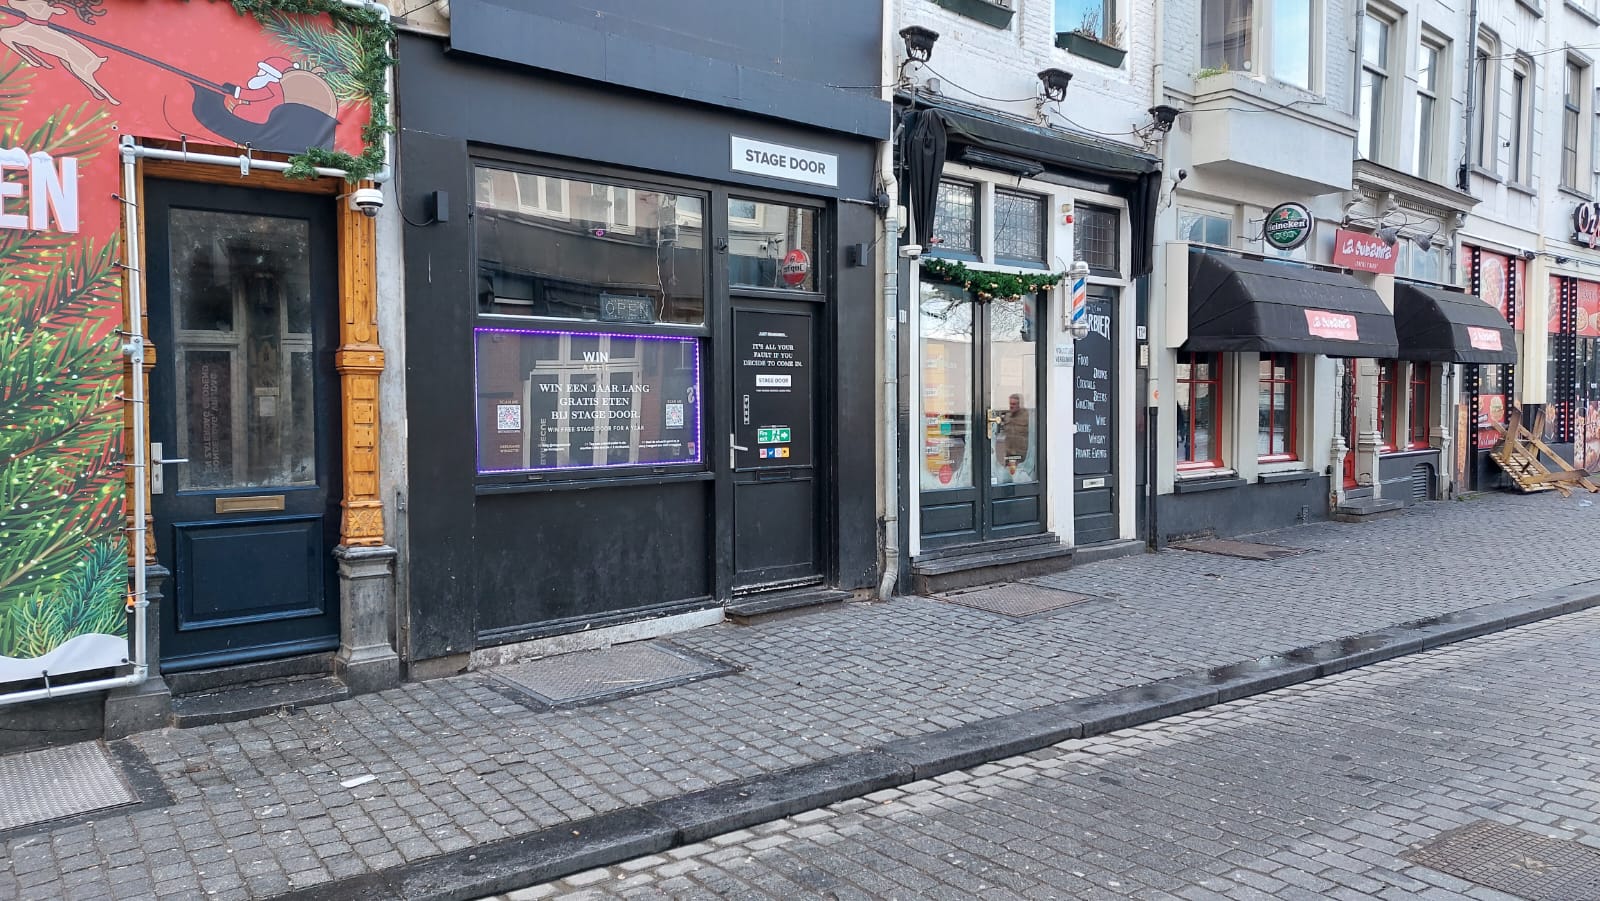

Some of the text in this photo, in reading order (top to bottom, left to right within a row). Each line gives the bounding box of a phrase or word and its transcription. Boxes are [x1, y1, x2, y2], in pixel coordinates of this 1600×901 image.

[745, 149, 826, 175] STAGE DOOR
[605, 302, 649, 317] OPEN
[583, 351, 609, 363] WIN
[539, 383, 650, 393] WIN EEN JAAR LANG
[559, 397, 630, 406] GRATIS ETEN
[551, 410, 640, 420] BIJ STAGE DOOR.
